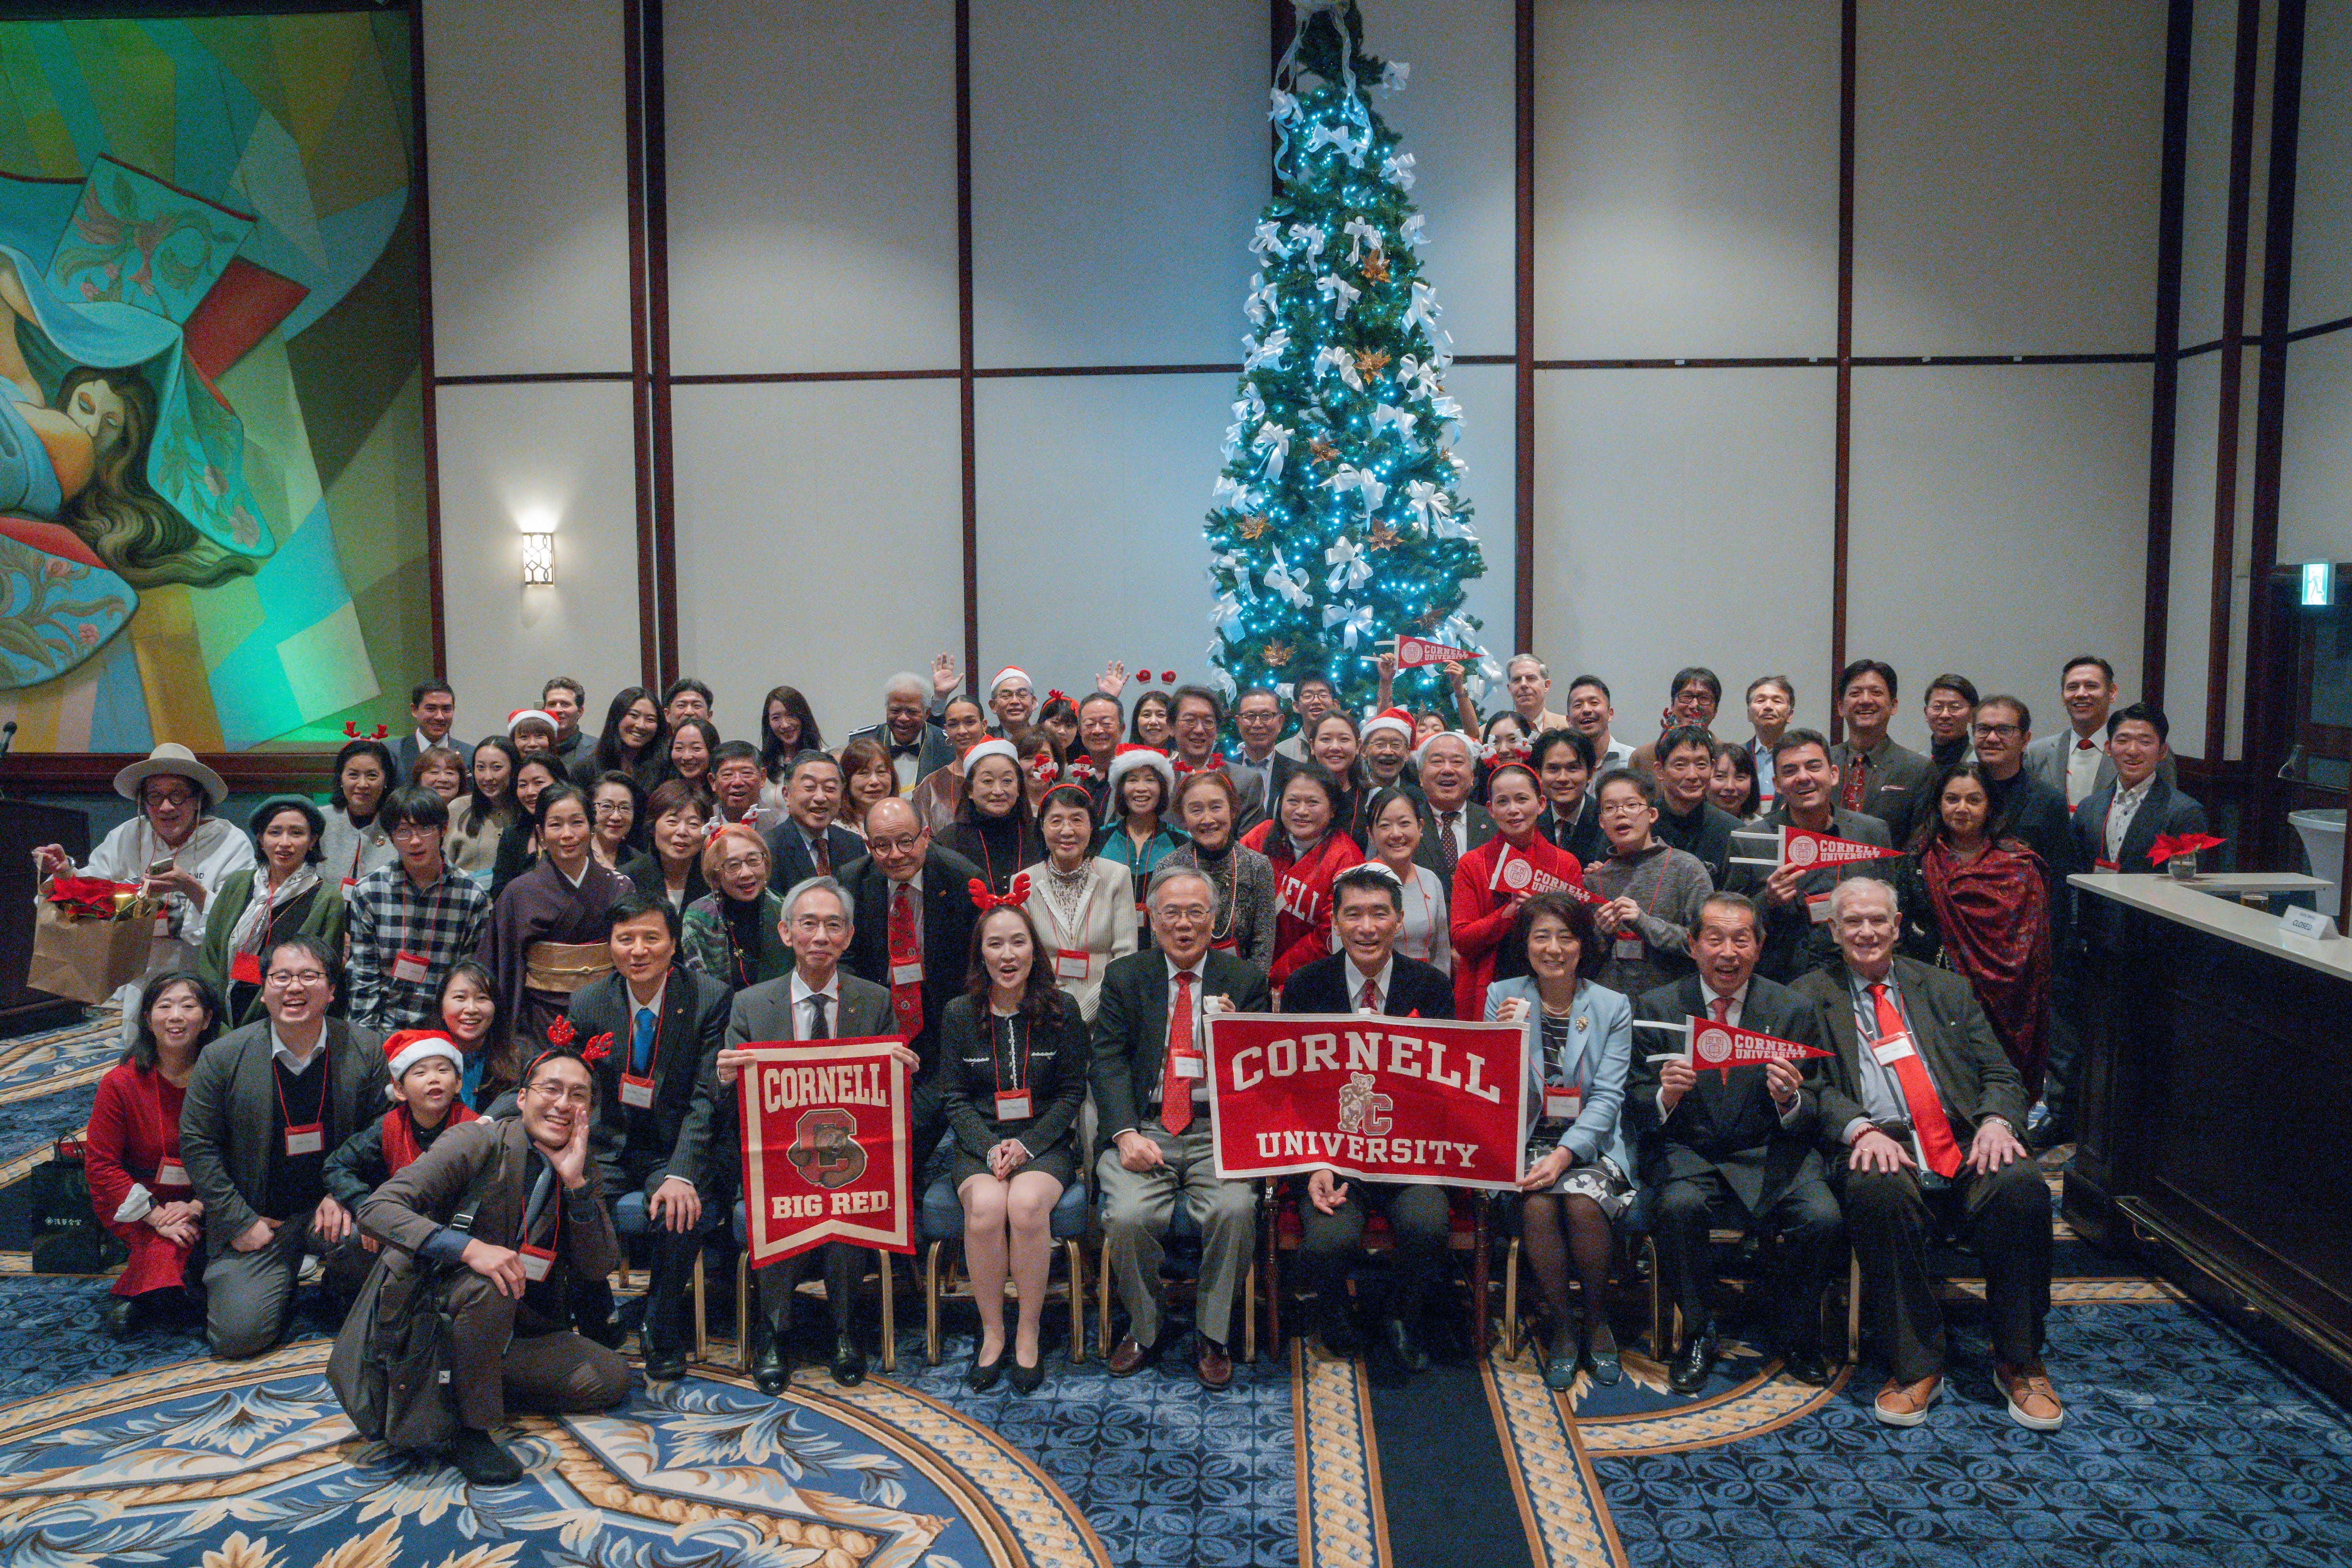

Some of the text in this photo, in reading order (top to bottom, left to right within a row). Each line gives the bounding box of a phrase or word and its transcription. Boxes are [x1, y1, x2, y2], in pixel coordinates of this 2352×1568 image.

[1424, 644, 1468, 656] CORNELL
[1819, 839, 1880, 854] CORNELL
[1820, 852, 1880, 862] UNIVERSITY
[1533, 869, 1590, 899] CORNELL
[2292, 920, 2312, 930] CLOSED
[1734, 1034, 1806, 1053] CORNELL
[1735, 1048, 1806, 1059] UNIVERSITY
[1232, 1032, 1500, 1104] CORNELL
[764, 1063, 886, 1113] CORNELL
[1256, 1131, 1479, 1167] UNIVERSITY
[772, 1190, 888, 1219] BIG RED
